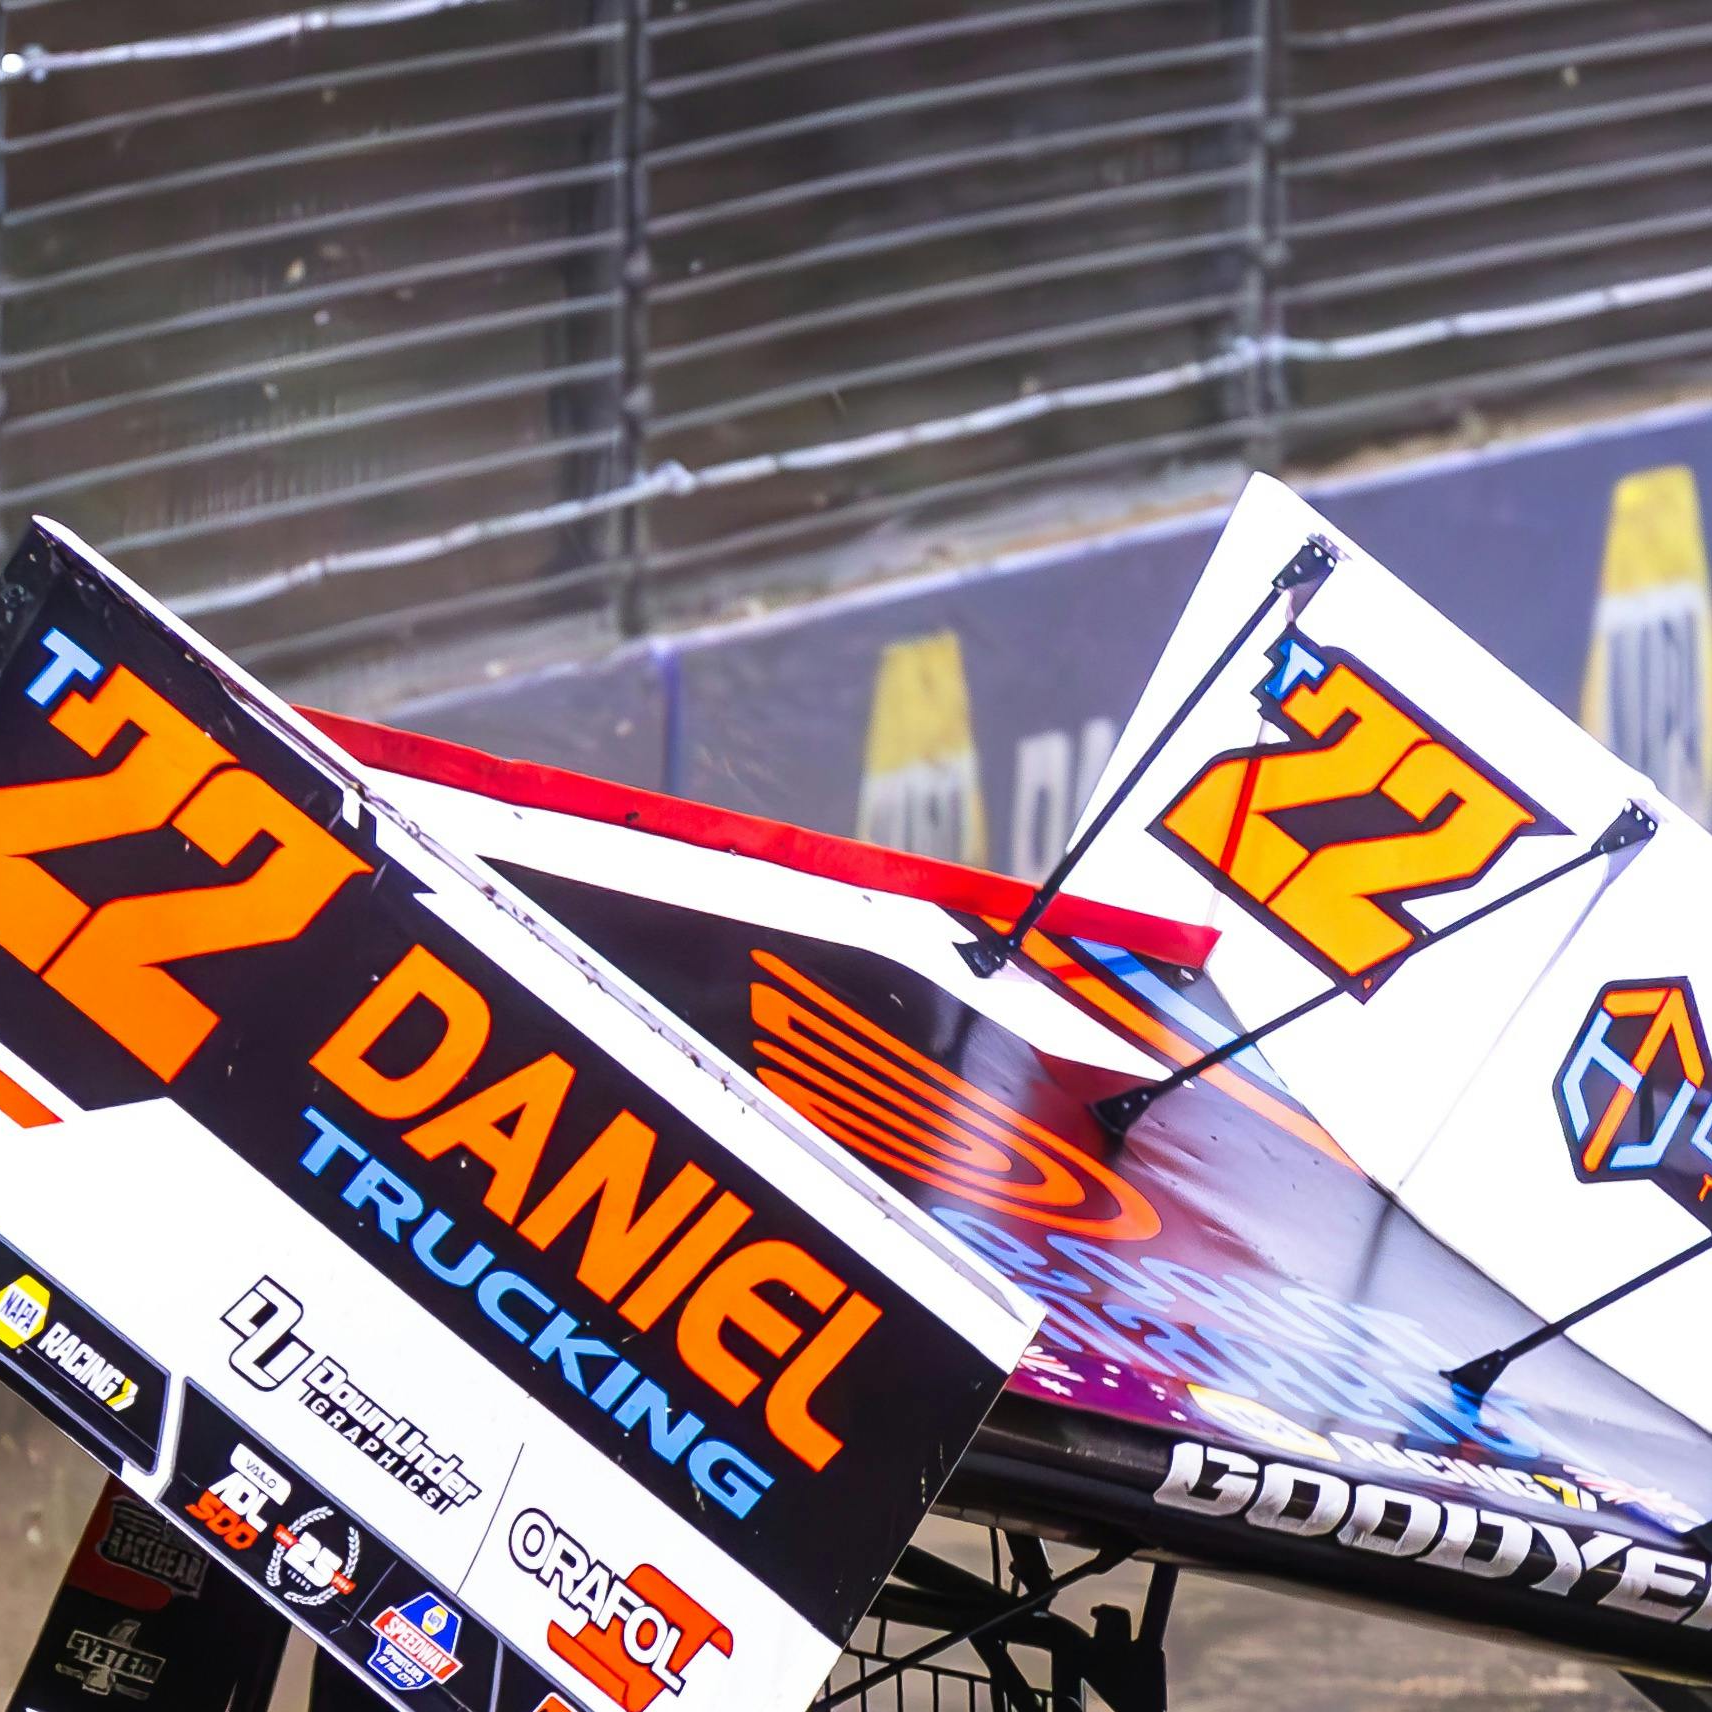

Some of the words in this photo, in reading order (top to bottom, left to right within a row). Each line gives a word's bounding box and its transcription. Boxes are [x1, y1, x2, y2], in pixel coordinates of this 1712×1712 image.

[308, 943, 884, 1473] DANIEL
[0, 1289, 40, 1335] NAPA
[37, 1322, 125, 1401] RACING
[298, 1106, 775, 1521] TRUCKING
[307, 1392, 444, 1511] GRAPHICS
[1329, 1431, 1556, 1503] RACING
[282, 1531, 343, 1588] 25
[509, 1508, 686, 1697] ORAFOL
[383, 1615, 452, 1676] SPEEDWAY
